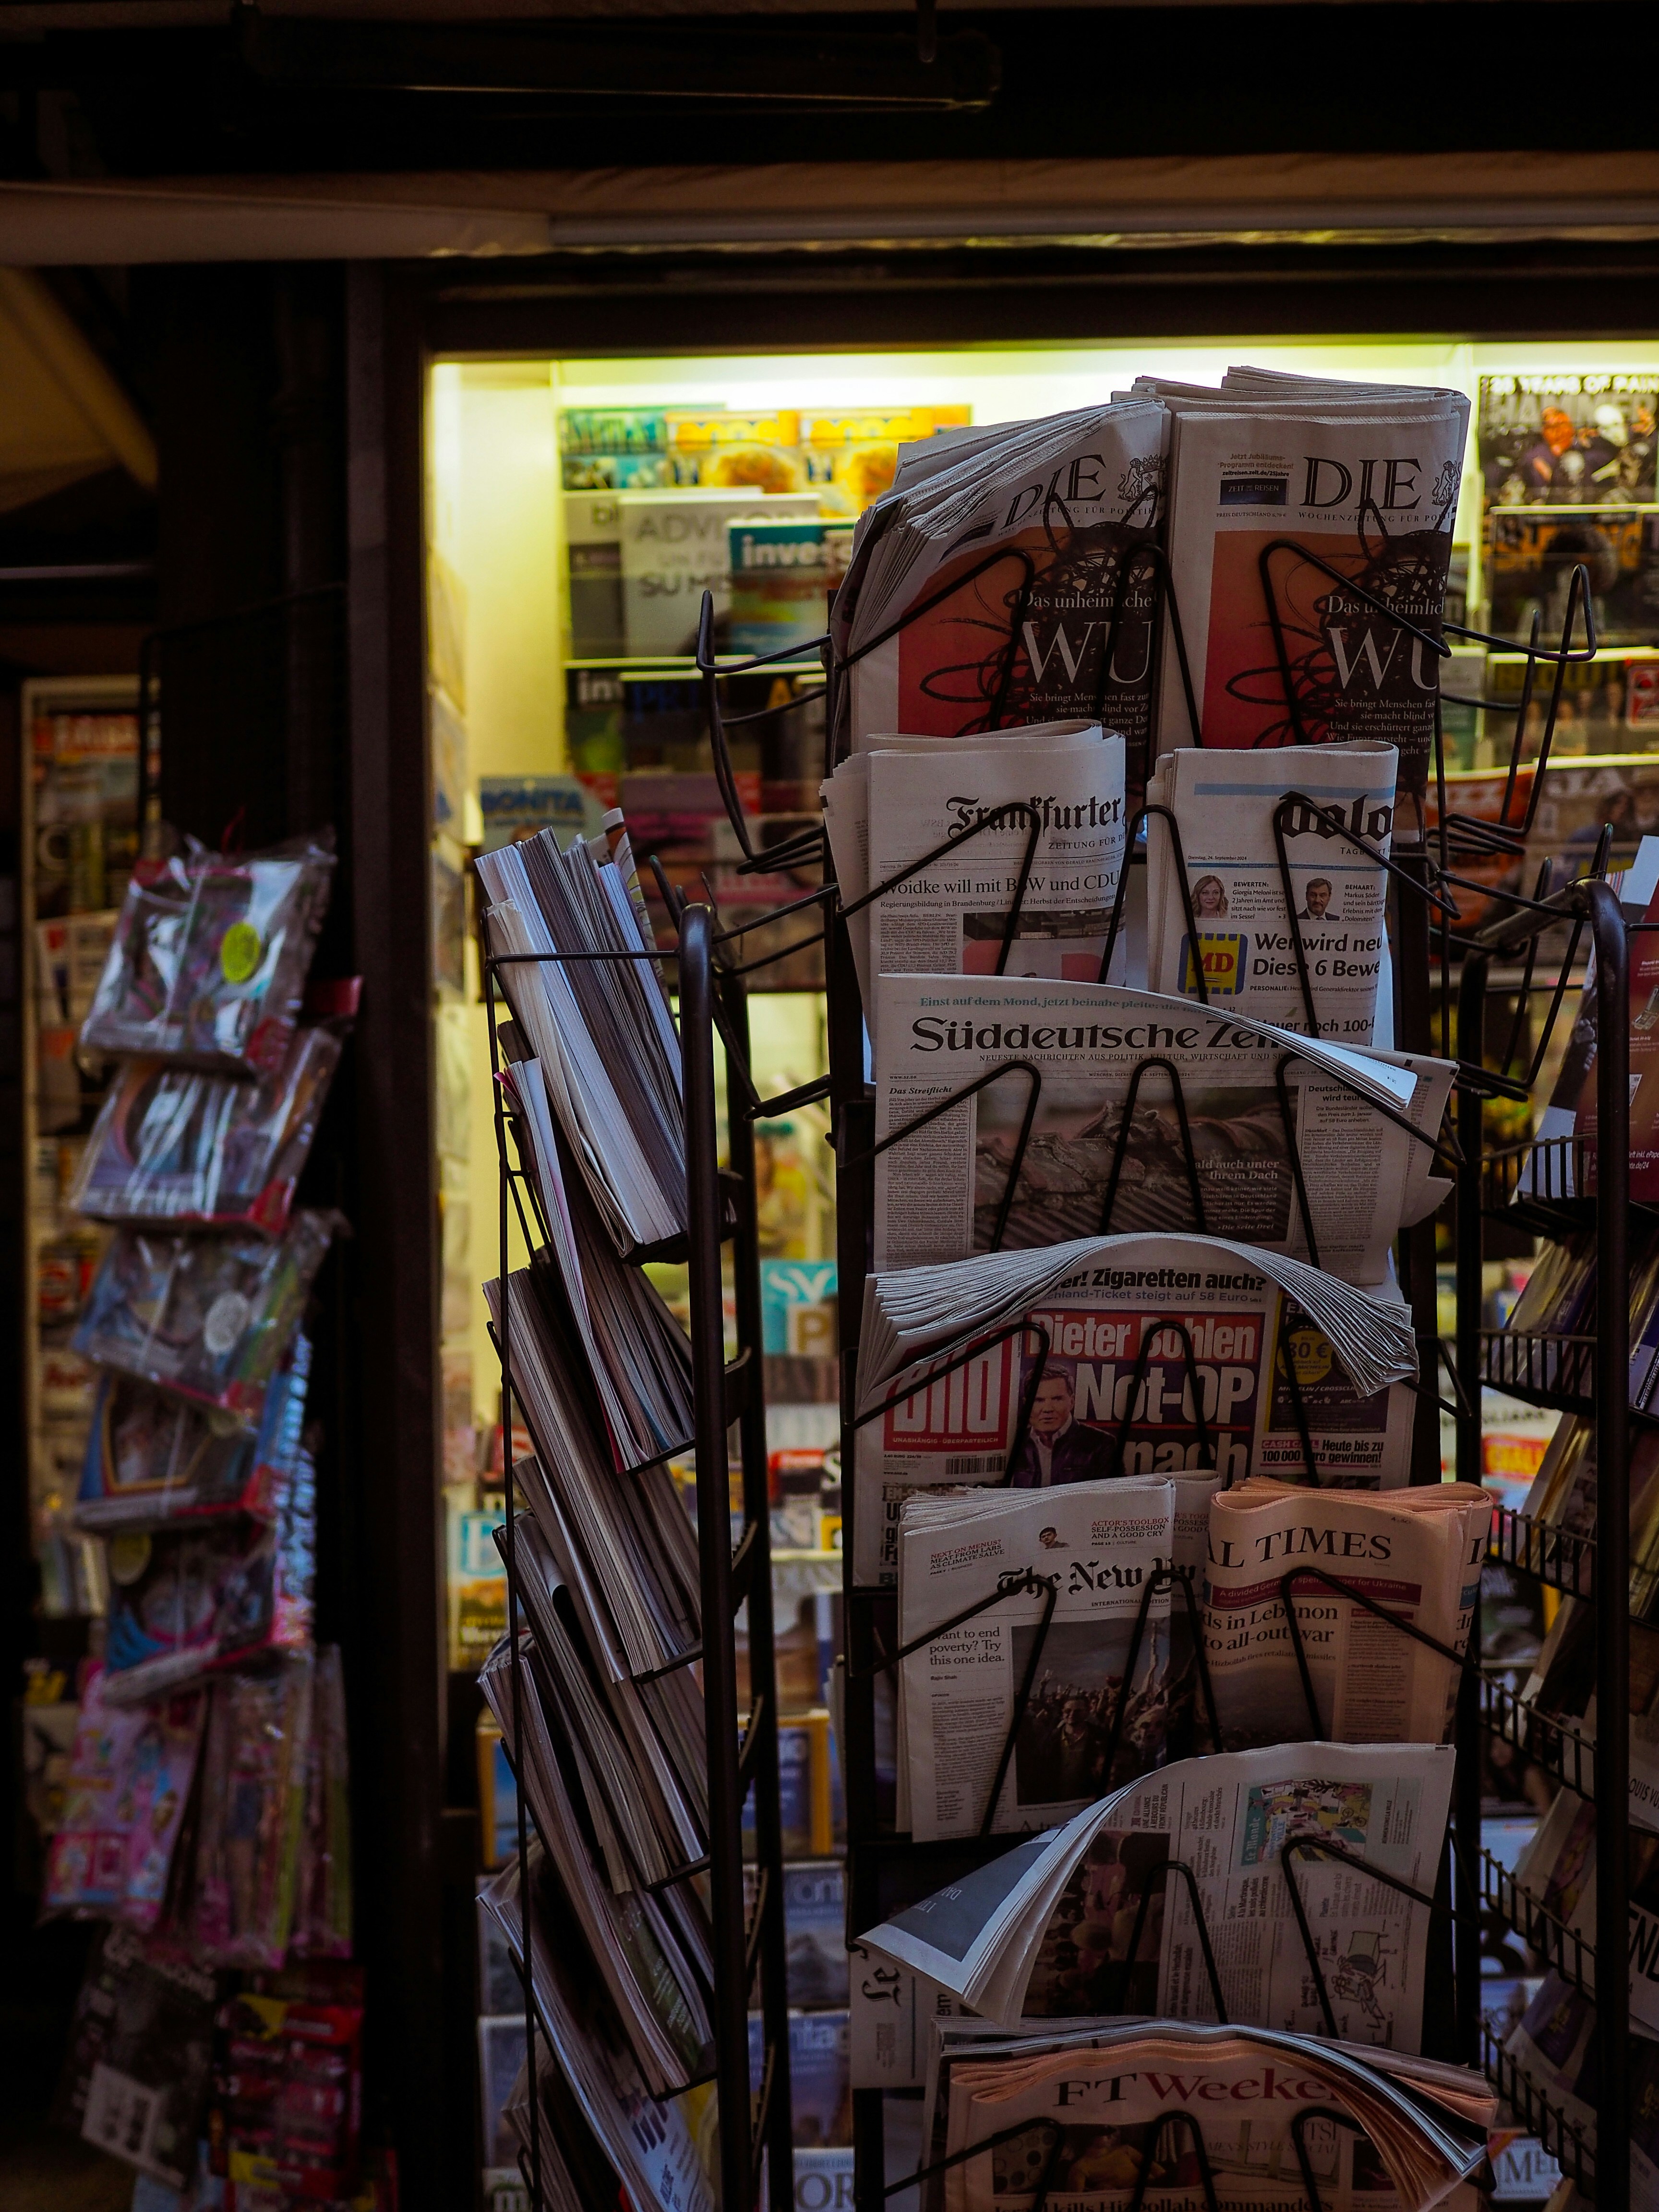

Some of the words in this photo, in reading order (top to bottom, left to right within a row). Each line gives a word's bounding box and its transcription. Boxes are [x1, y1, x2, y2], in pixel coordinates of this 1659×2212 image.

[1299, 456, 1422, 510] DIE
[1000, 454, 1106, 529] DIE
[1019, 590, 1050, 607] Das
[1056, 591, 1152, 608] unheimche
[1328, 595, 1360, 613] Das
[1364, 597, 1444, 615] uheimlic
[1030, 693, 1044, 702] Sie
[1046, 693, 1071, 704] bringt
[1335, 698, 1347, 707] Sie
[1351, 699, 1376, 709] bringt
[1379, 699, 1422, 709] Menschen
[1361, 710, 1372, 719] sie
[1375, 710, 1401, 719] macht
[1404, 710, 1425, 720] blind
[1330, 721, 1349, 730] Und
[1365, 722, 1409, 731] erschüttert
[1327, 733, 1344, 742] Wie
[1400, 747, 1419, 757] geht
[1048, 841, 1095, 849] ZEITUNG
[1099, 837, 1115, 846] FÜR
[880, 879, 939, 894] Woidke
[944, 879, 971, 893] will
[976, 878, 1001, 892] mit
[1005, 877, 1046, 891] BW
[1050, 877, 1079, 890] und
[1084, 870, 1119, 889] CDU
[952, 900, 995, 908] Brandenburg
[1066, 894, 1115, 903] Entscheidungen
[1255, 933, 1295, 950] Wer
[1302, 933, 1348, 951] wird
[1353, 936, 1382, 951] neu
[1315, 960, 1327, 976] 6
[1333, 960, 1380, 976] Bewe
[920, 997, 949, 1007] Einst
[953, 997, 973, 1006] auf
[974, 997, 1000, 1006] dem
[1004, 997, 1040, 1007] Mond,
[1043, 997, 1069, 1008] jetzt
[1072, 998, 1118, 1008] beinahe
[911, 1017, 1199, 1051] Süddeutsche
[909, 1086, 952, 1095] Streiflicht
[1215, 1159, 1244, 1168] auch
[1247, 1160, 1279, 1168] unter
[1210, 1170, 1246, 1179] Ihrem
[1248, 1170, 1278, 1179] Dach
[1092, 1268, 1202, 1291] Zigaretten
[1205, 1274, 1267, 1291] auch?
[1136, 1291, 1171, 1301] steigt
[1176, 1291, 1196, 1301] auf
[1200, 1292, 1214, 1301] 58
[1219, 1292, 1248, 1302] Euro
[1030, 1314, 1131, 1357] Dieter
[1141, 1317, 1255, 1360] Bohlen
[1073, 1362, 1255, 1424] Not-OP
[1262, 1441, 1286, 1449] CASH
[1322, 1441, 1351, 1451] Heute
[1354, 1441, 1369, 1451] bis
[1372, 1443, 1384, 1451] zu
[1328, 1451, 1382, 1463] gewinnen!
[1129, 1517, 1169, 1526] TOOLBOX
[1092, 1524, 1165, 1533] SELF-POSSESSION
[931, 1550, 952, 1559] NEXT
[968, 1539, 1001, 1551] MENUS?
[1256, 1527, 1392, 1563] TIMES
[930, 1555, 953, 1564] MEAT
[955, 1549, 979, 1559] FROM
[981, 1544, 1002, 1552] LABS
[942, 1554, 978, 1567] CLIMATE
[979, 1549, 1005, 1559] SALVE
[998, 1566, 1062, 1599] The
[1069, 1560, 1144, 1595] New
[1228, 1585, 1259, 1596] divided
[1226, 1614, 1245, 1630] in
[1250, 1604, 1338, 1626] Lebnon
[964, 1629, 975, 1638] to
[979, 1627, 1000, 1638] end
[1227, 1627, 1290, 1650] all-out
[1299, 1630, 1335, 1643] war
[930, 1640, 978, 1655] poverty?
[982, 1640, 1001, 1653] Try
[930, 1654, 951, 1665] this
[954, 1655, 975, 1664] one
[978, 1652, 1005, 1663] idea.
